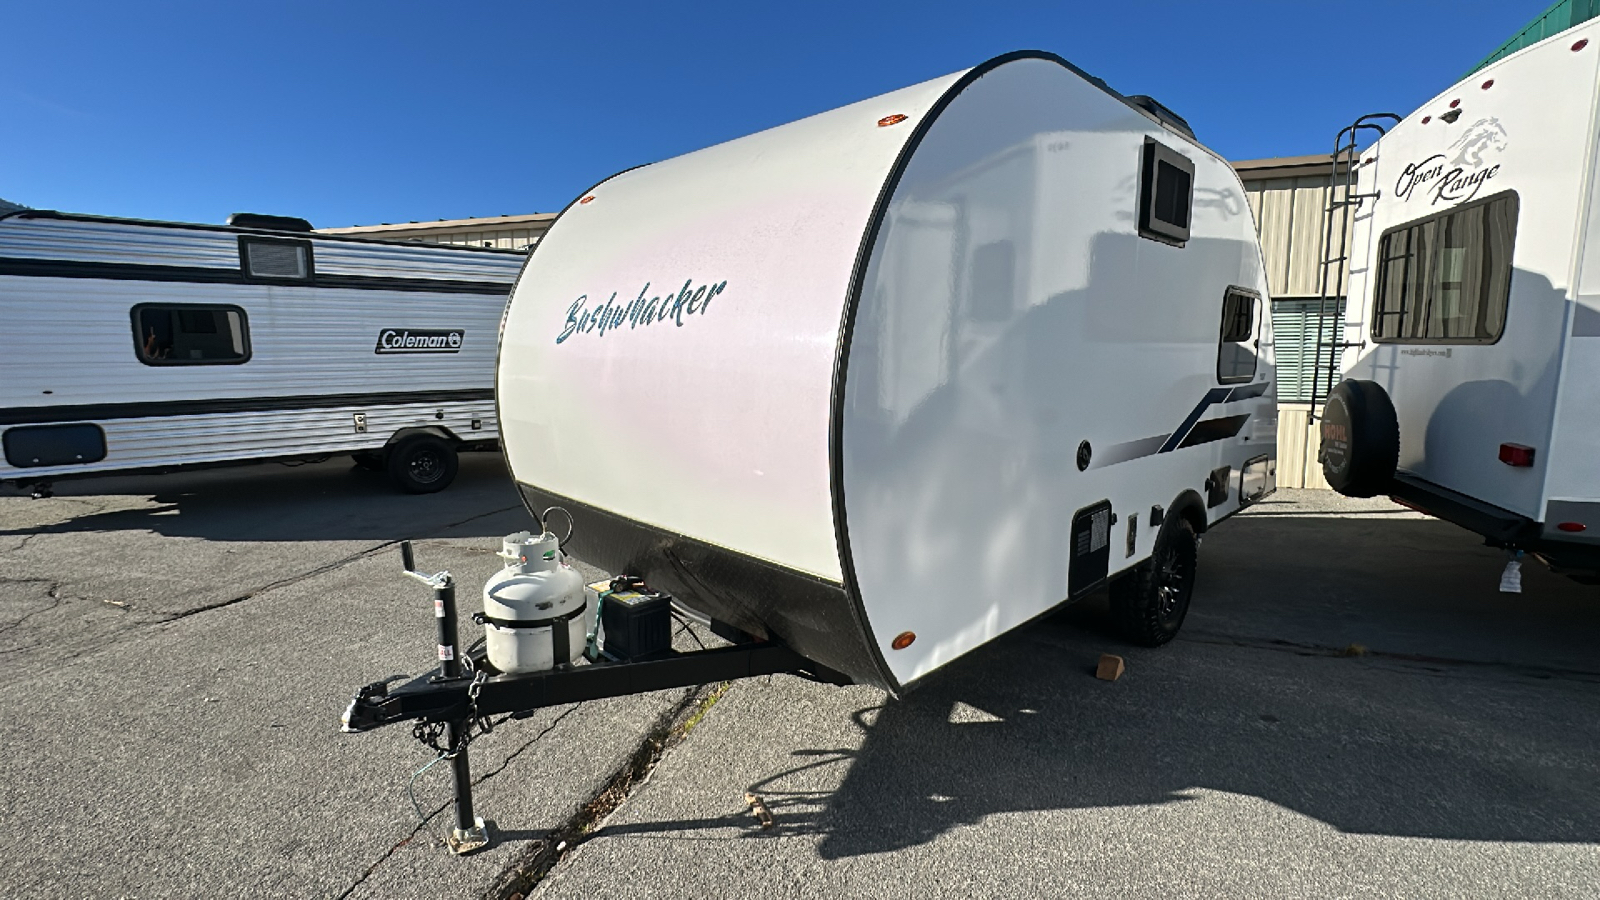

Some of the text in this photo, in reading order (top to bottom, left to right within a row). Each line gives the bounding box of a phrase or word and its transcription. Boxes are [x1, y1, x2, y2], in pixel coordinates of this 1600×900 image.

[1395, 154, 1446, 202] Open
[1427, 164, 1500, 205] Range
[556, 278, 728, 345] Bushwhacker
[381, 330, 447, 349] Coleman
